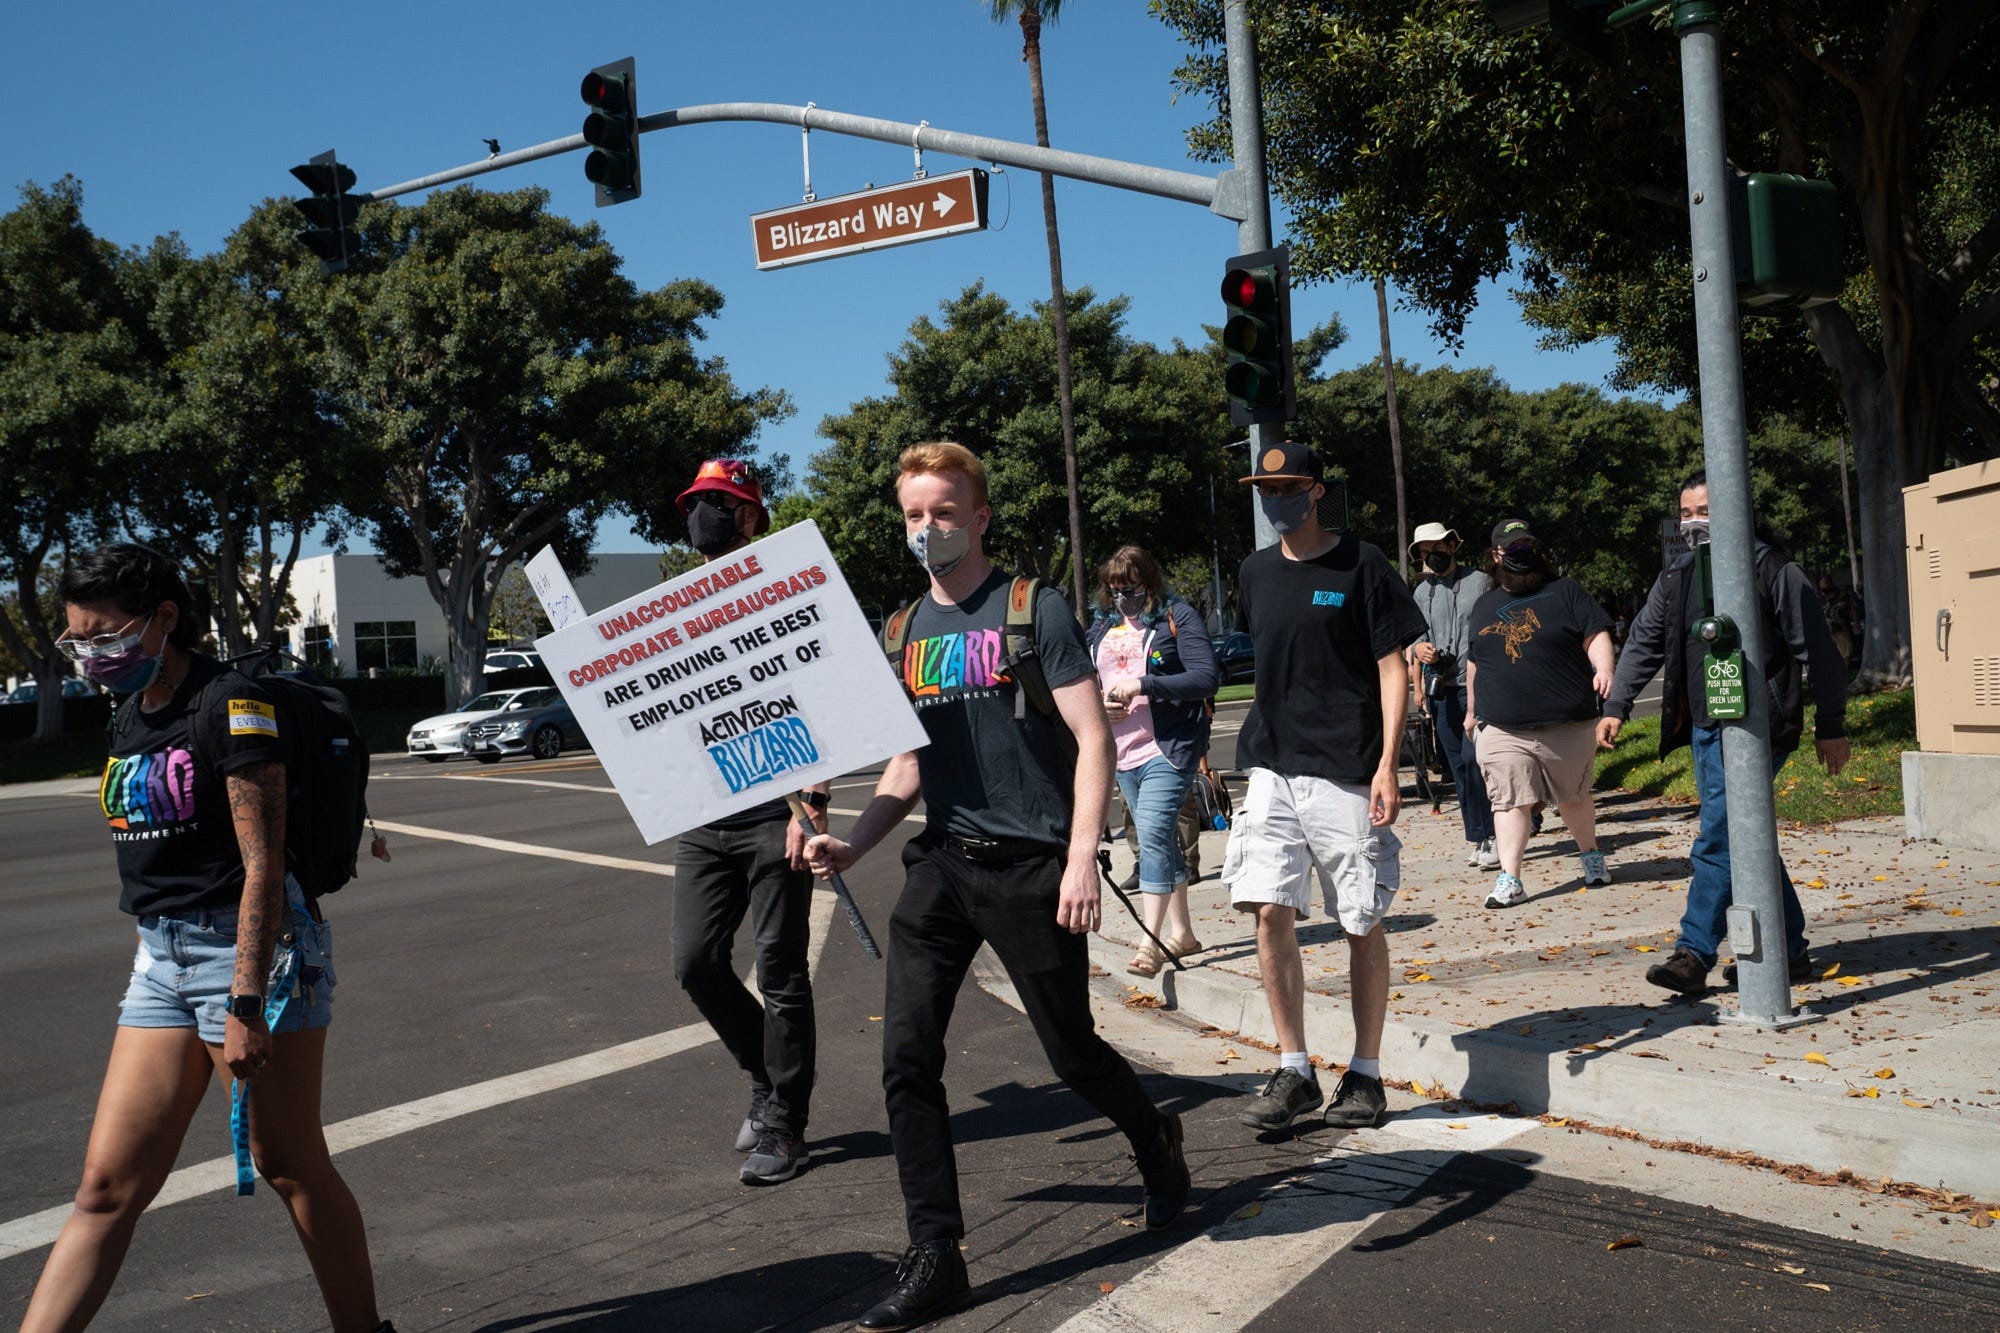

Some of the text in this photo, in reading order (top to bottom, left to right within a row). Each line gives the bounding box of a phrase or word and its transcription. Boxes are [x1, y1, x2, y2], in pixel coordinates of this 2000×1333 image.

[770, 202, 925, 250] Blizzard Way
[1665, 535, 1687, 545] PARK
[598, 555, 763, 641] UNACCOUNTABLE
[1312, 590, 1345, 608] BLIZZARD
[568, 565, 827, 687] CORPORATE BUREAUCRATS
[604, 603, 822, 708] ARE DRIVING THE BEST
[232, 702, 260, 710] hello
[628, 639, 822, 731] EMPLOYEES OUT OF
[1707, 679, 1742, 688] PUSH BUTTON
[1709, 695, 1741, 704] GREEN LIGHT
[699, 694, 800, 746] ACTIVISION
[707, 716, 819, 794] BLIZZARD
